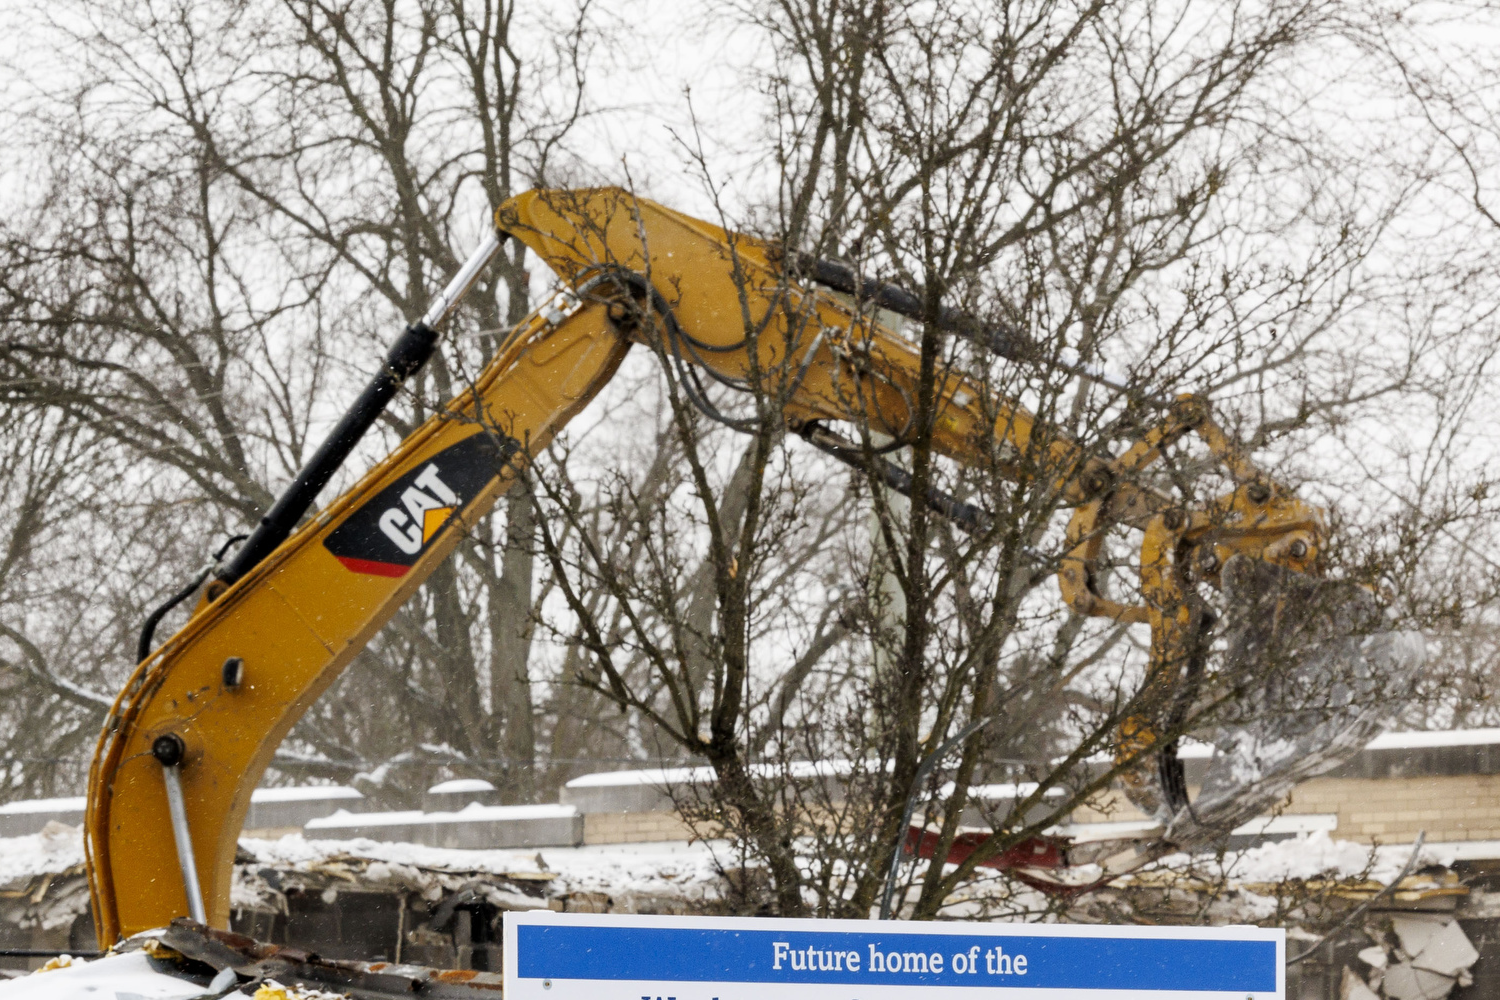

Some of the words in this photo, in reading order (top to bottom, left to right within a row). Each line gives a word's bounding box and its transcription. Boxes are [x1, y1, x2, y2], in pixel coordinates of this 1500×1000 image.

[378, 462, 462, 555] CAT
[772, 942, 861, 972] Future
[868, 943, 944, 973] home
[951, 946, 981, 974] of
[985, 946, 1028, 975] the
